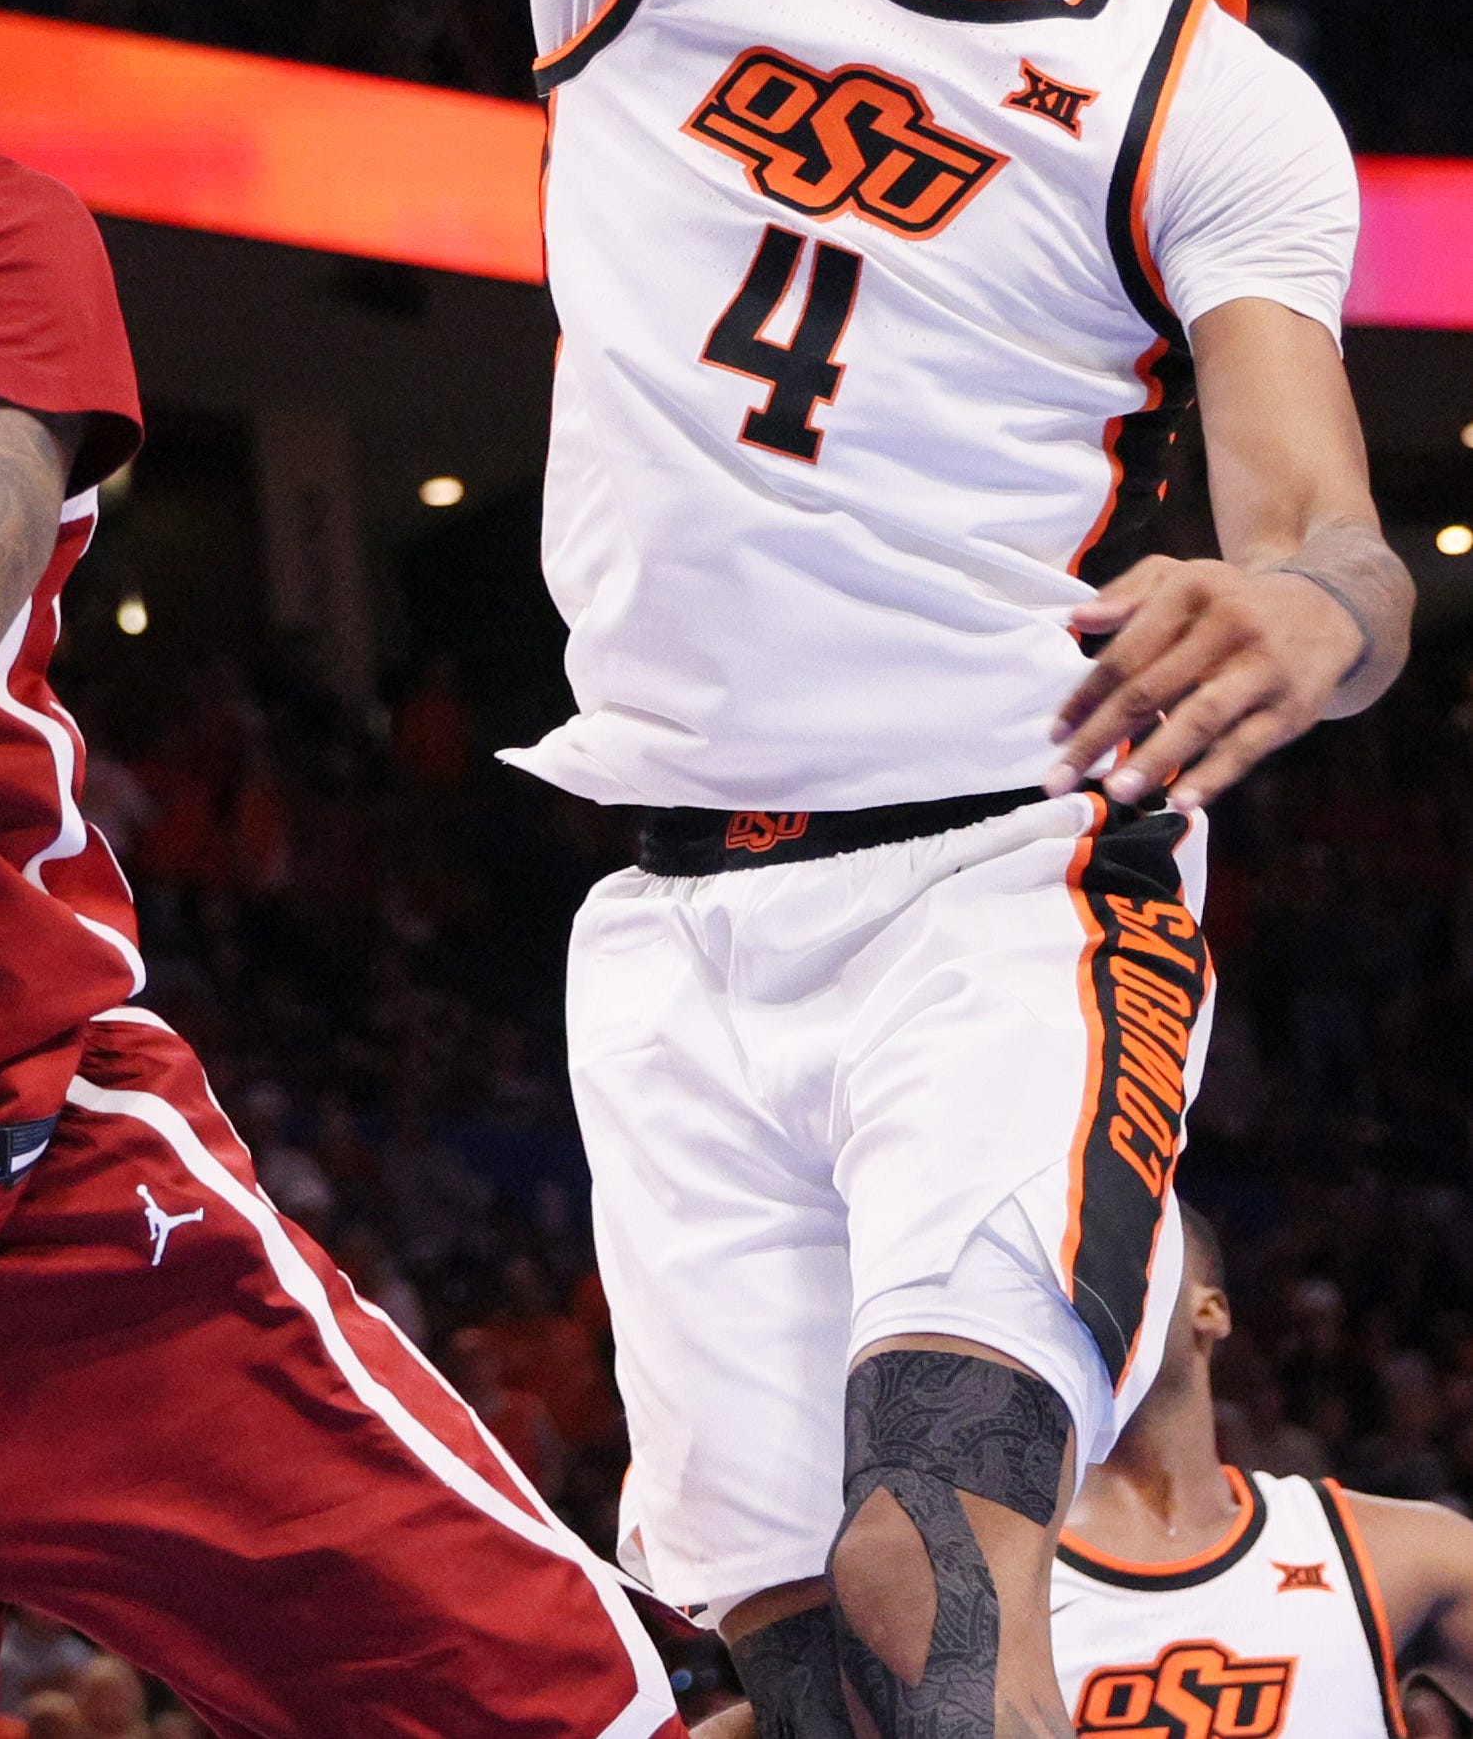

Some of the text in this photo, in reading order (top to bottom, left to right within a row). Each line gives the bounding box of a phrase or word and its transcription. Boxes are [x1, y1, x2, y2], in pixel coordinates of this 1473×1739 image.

[688, 51, 1000, 235] OSU
[1006, 63, 1094, 135] XII
[698, 223, 864, 465] 4
[1106, 893, 1197, 1198] COWBOYS
[1077, 1641, 1293, 1739] OSU
